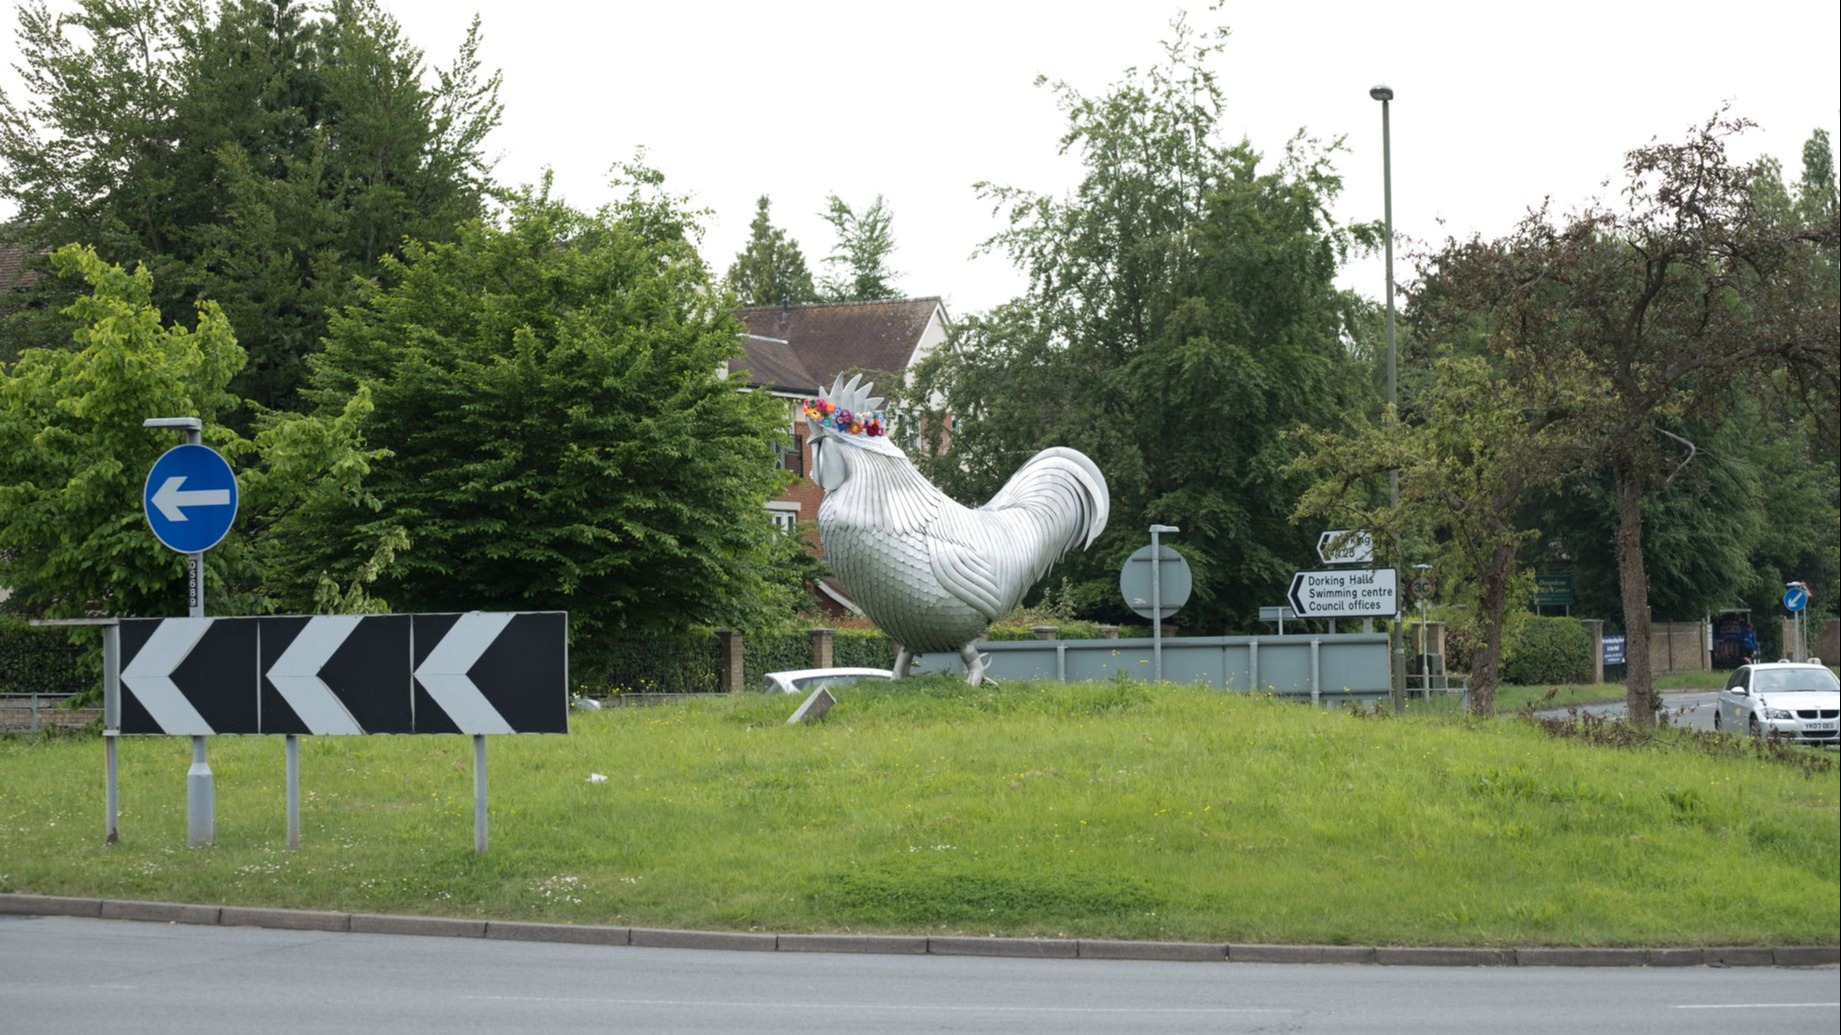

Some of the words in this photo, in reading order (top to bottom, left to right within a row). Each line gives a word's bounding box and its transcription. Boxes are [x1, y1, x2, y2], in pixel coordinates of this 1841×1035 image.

[1308, 576, 1345, 587] Dorking
[1349, 574, 1374, 585] Halls
[1309, 587, 1358, 599] Swimming
[1361, 587, 1393, 597] centre
[1309, 601, 1344, 611] Council
[1348, 600, 1381, 610] offices
